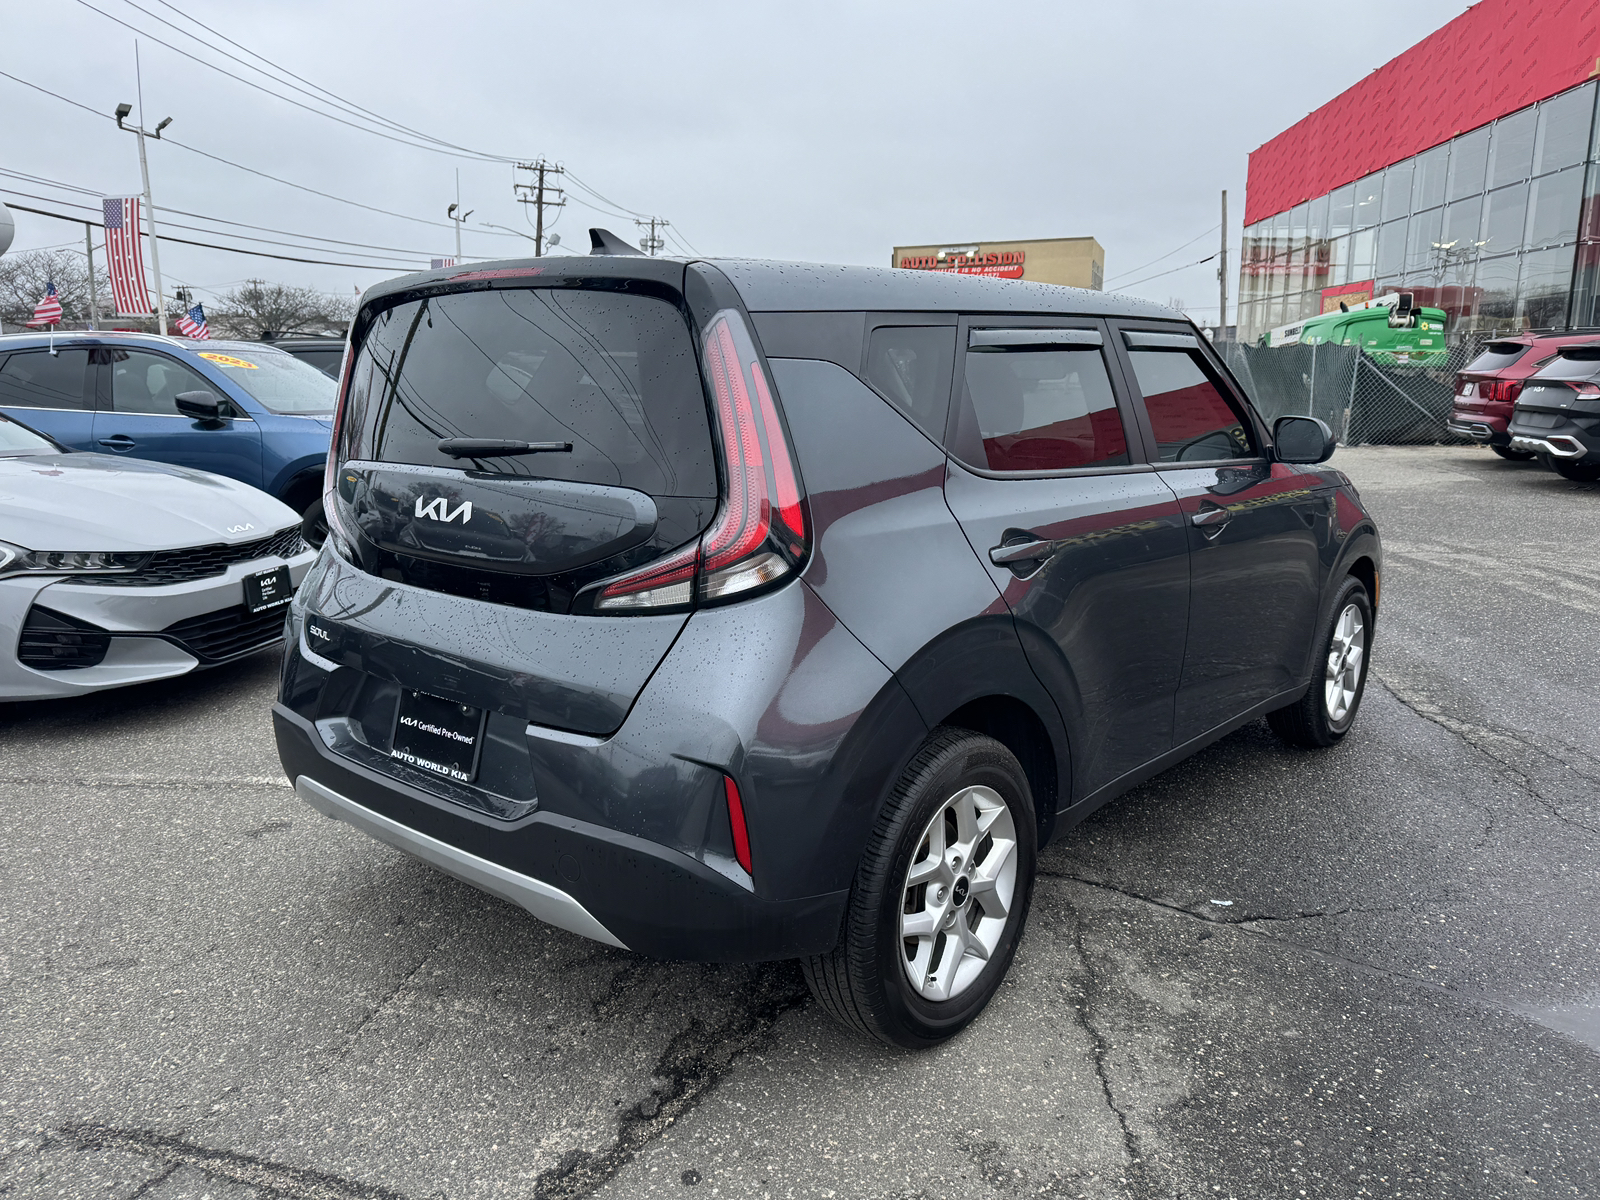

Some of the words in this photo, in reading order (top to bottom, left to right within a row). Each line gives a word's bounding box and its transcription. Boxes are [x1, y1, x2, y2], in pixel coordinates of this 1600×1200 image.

[901, 256, 938, 269] AUTO
[947, 251, 1025, 267] COLLISION
[1387, 334, 1418, 345] JLG
[415, 495, 472, 524] KIA
[227, 523, 254, 533] KIA
[260, 576, 277, 587] KIA
[253, 604, 267, 613] AUTO
[266, 599, 285, 609] WORLD
[310, 625, 330, 641] SOUL
[400, 716, 418, 727] KIA
[418, 721, 442, 735] Certified
[441, 728, 473, 745] Pre-Owned
[390, 749, 415, 763] AUTO
[416, 758, 449, 775] WORLD
[450, 769, 468, 782] KIA
